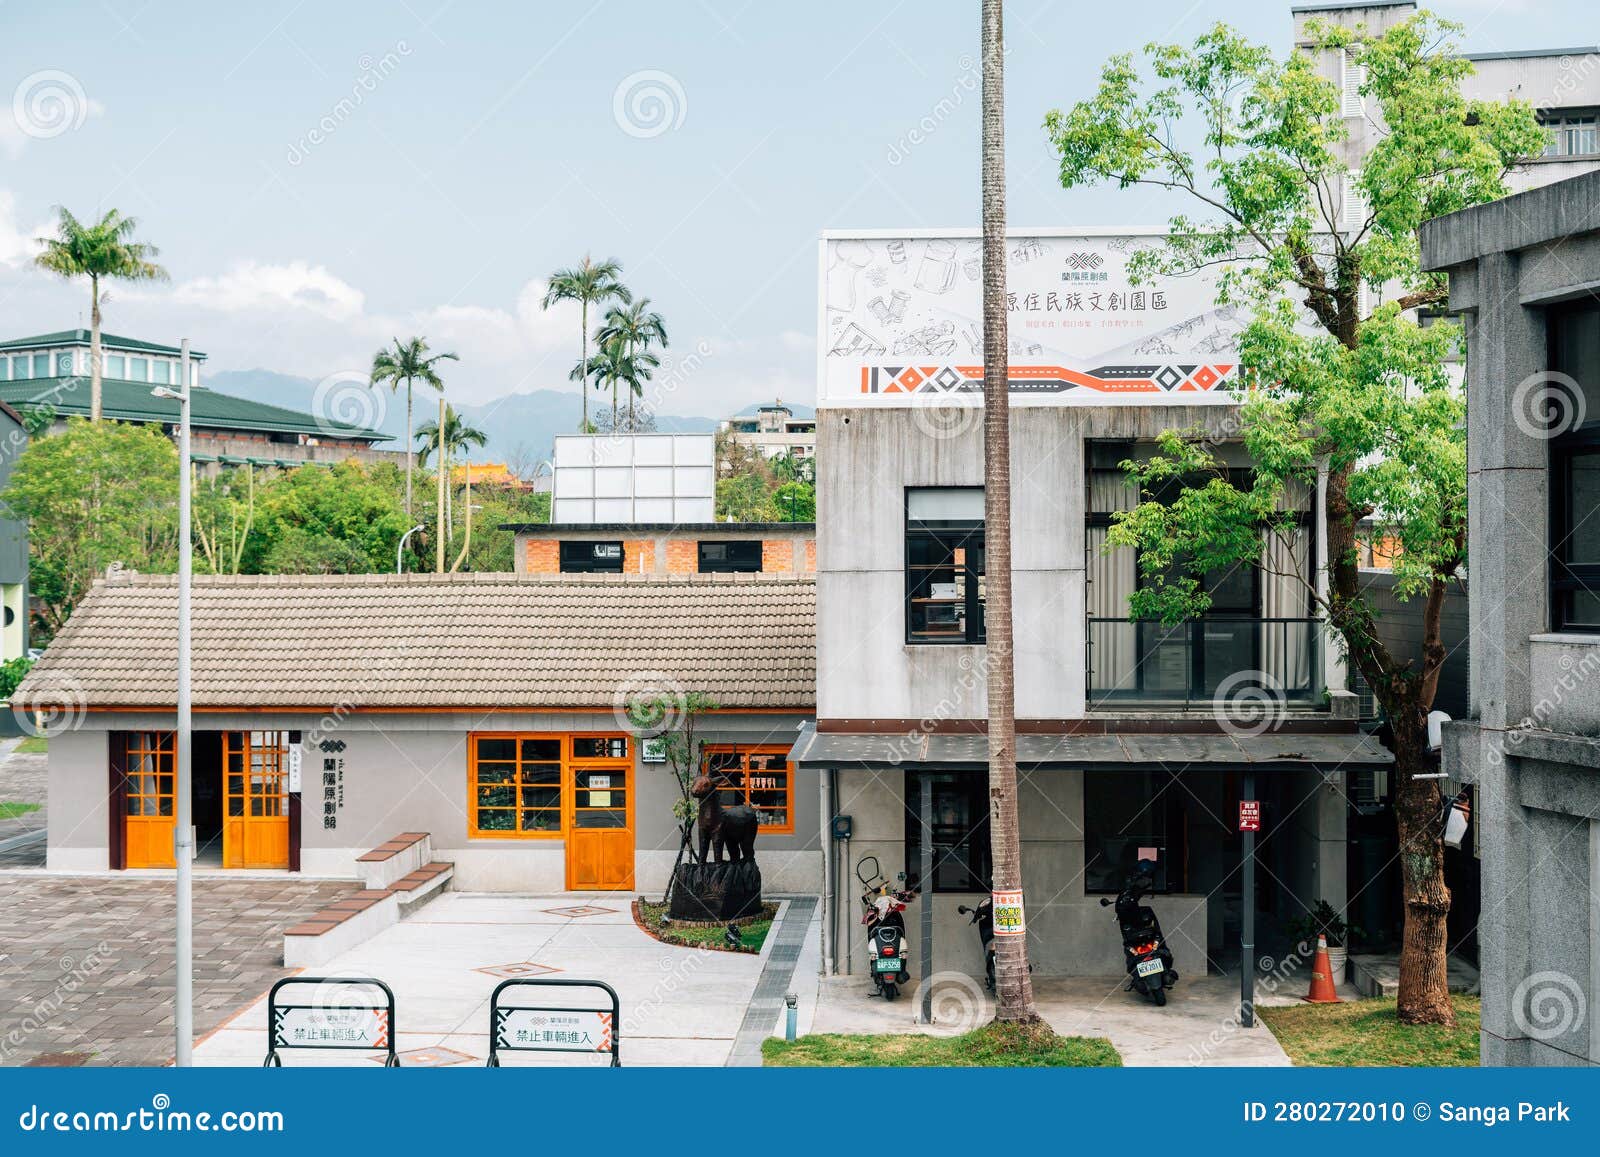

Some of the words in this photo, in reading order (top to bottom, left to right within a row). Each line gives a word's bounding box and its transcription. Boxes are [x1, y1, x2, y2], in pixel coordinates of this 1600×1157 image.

[294, 1027, 370, 1041] 禁止車輛進入
[516, 1029, 593, 1044] 禁止車輛進入
